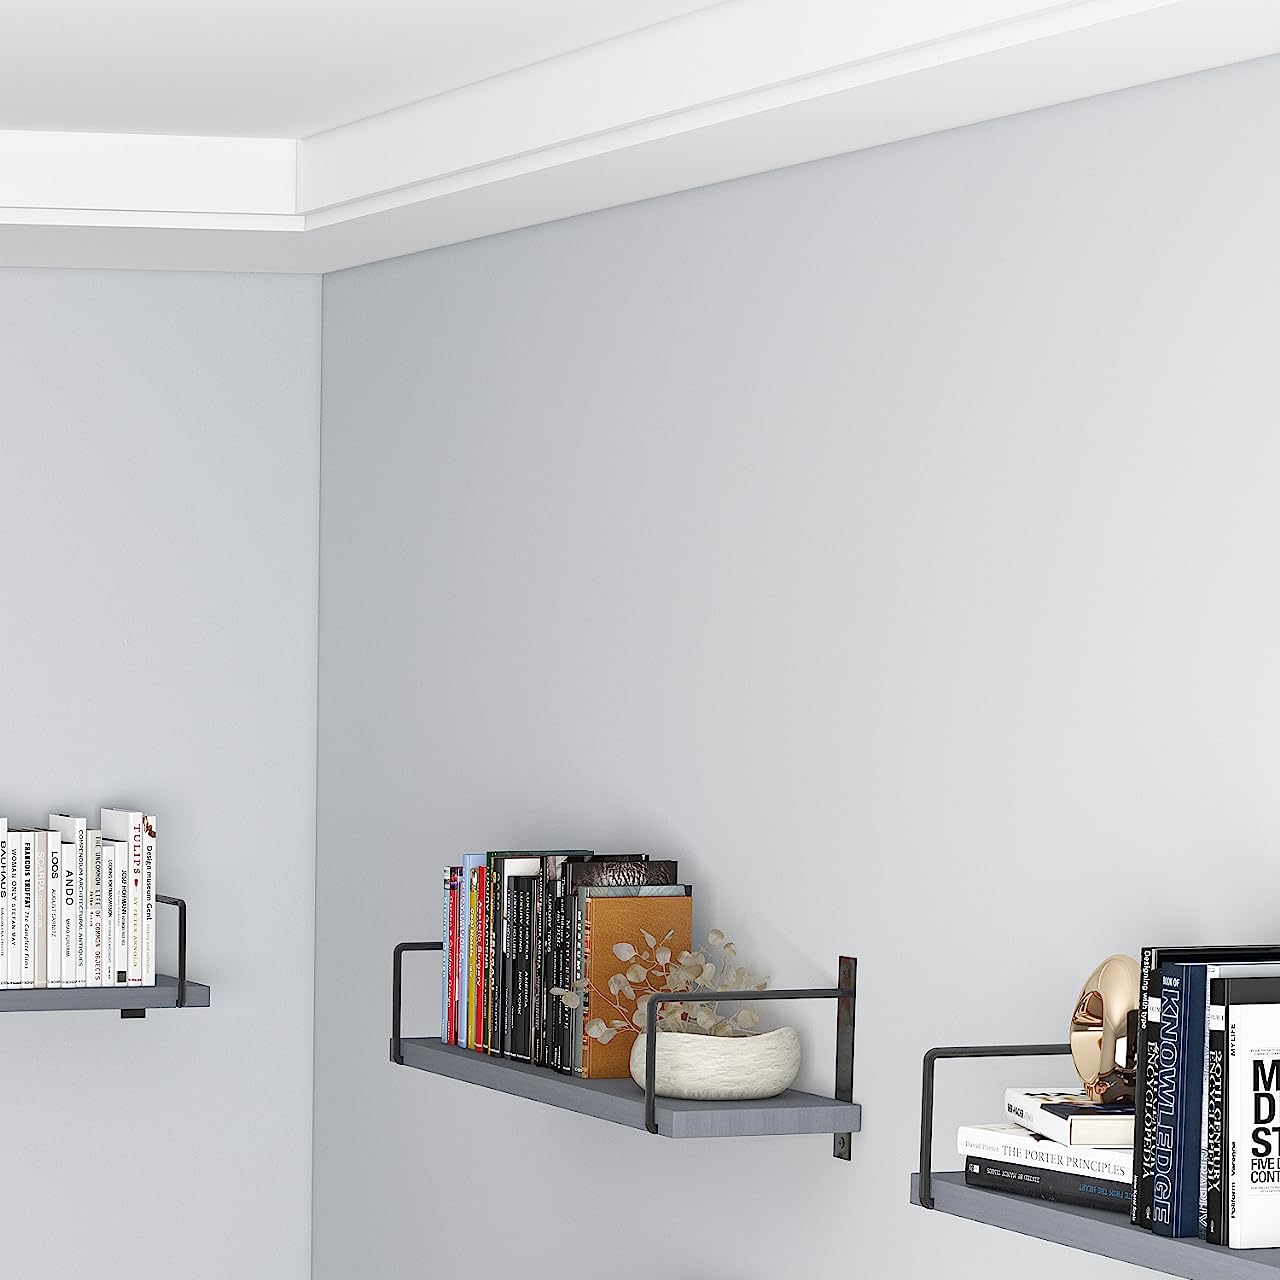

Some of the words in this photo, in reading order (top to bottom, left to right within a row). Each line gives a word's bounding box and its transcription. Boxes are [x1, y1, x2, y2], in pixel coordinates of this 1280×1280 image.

[133, 824, 141, 874] TULIPS
[145, 845, 153, 870] Design
[37, 851, 45, 891] SCARPA
[66, 870, 74, 906] ANDO
[1141, 950, 1151, 991] Designing
[1141, 992, 1150, 1009] with
[1152, 988, 1180, 1224] KNOWLEDGE
[1002, 1145, 1022, 1159] THE
[1025, 1149, 1063, 1166] PORTER
[1066, 1155, 1126, 1177] PRINCIPLES
[1251, 1158, 1275, 1170] FIVE
